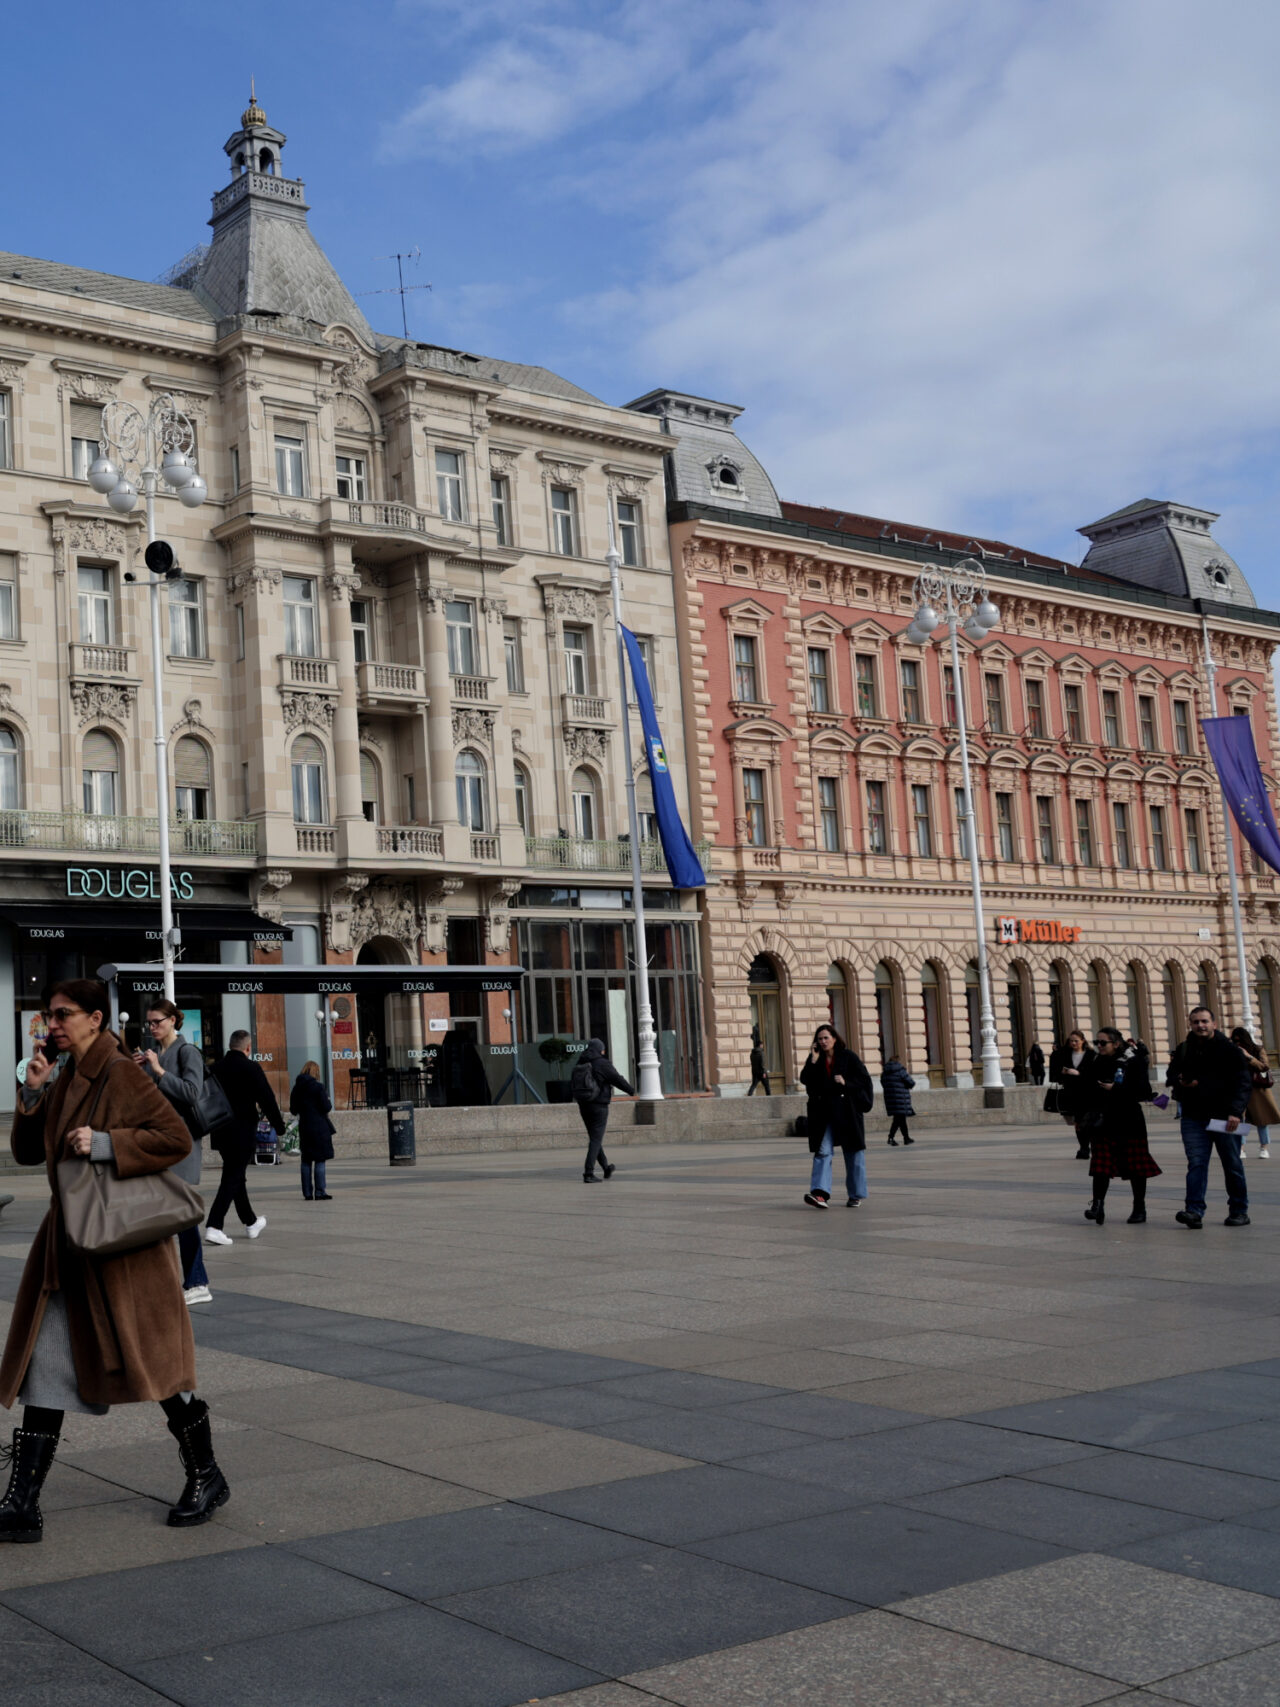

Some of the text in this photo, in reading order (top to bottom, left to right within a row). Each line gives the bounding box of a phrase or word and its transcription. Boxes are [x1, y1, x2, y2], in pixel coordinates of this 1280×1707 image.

[66, 868, 194, 900] DOUGLAS
[30, 929, 65, 938] DOUGLAS
[1020, 918, 1083, 943] Müller
[253, 932, 285, 941] DOUGLAS
[228, 982, 263, 992] DOUGLAS
[318, 982, 352, 992] DOUGLAS
[403, 982, 435, 991] DOUGLAS
[482, 981, 512, 990] DOUGLAS
[408, 1049, 438, 1058] DOUGLAS
[490, 1046, 518, 1055] DOUGLAS
[332, 1051, 362, 1060] DOUGLAS
